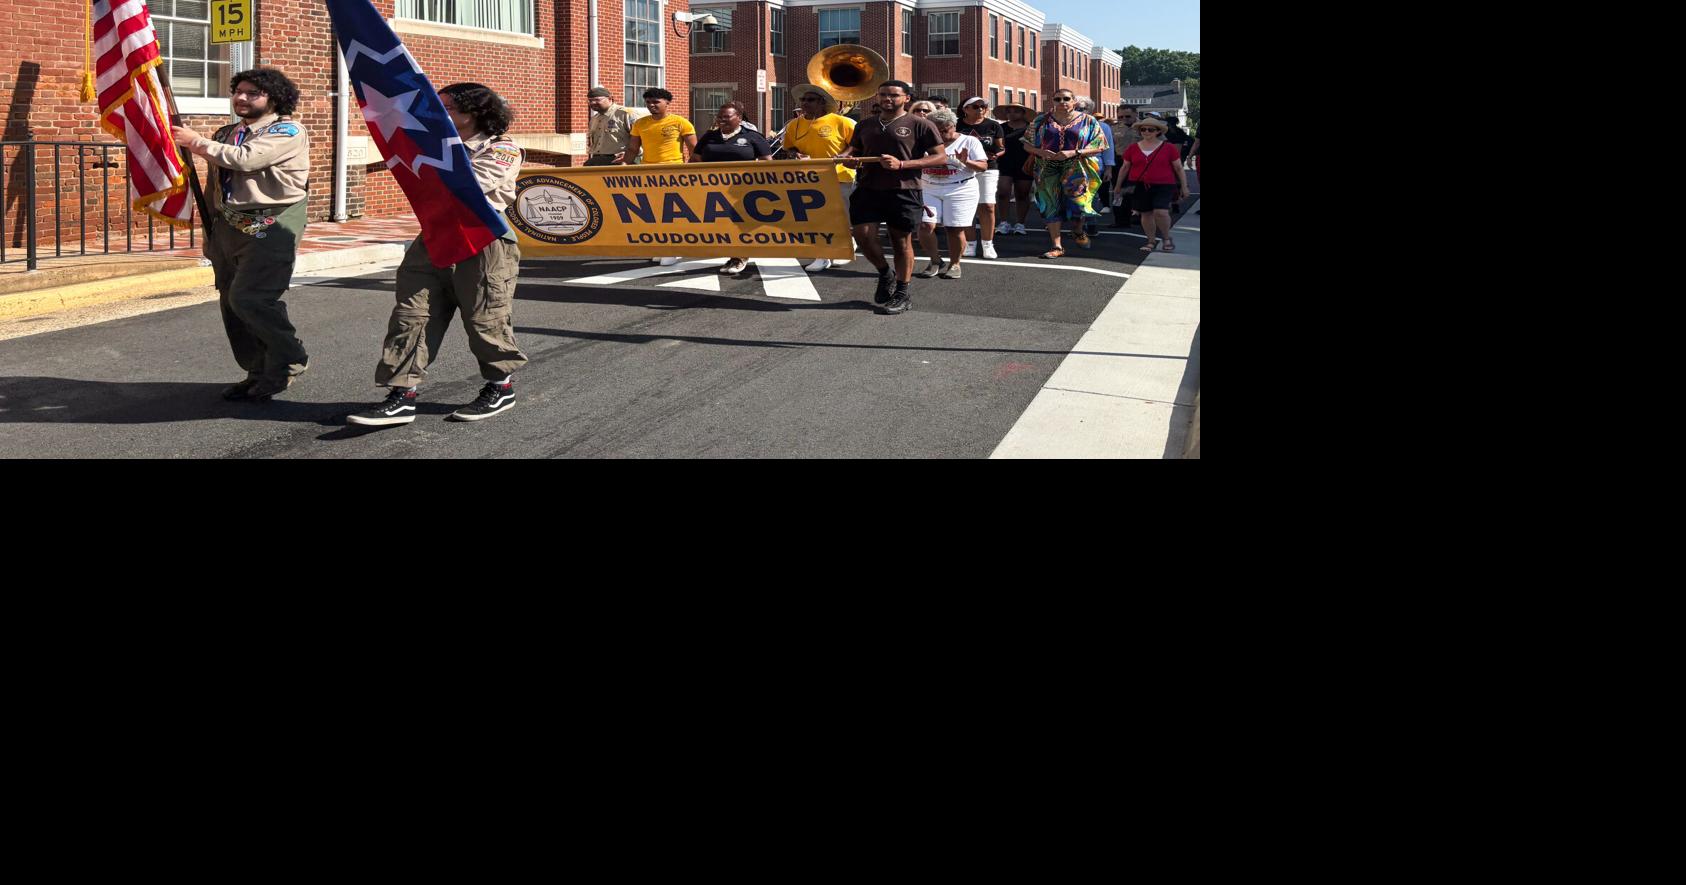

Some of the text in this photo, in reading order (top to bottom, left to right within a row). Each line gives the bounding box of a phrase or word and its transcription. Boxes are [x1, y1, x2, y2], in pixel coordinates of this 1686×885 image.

[218, 3, 243, 25] 15
[219, 28, 243, 38] MPH
[536, 178, 587, 198] ADVANCEMENT
[602, 170, 820, 189] WWW.NAACPLOUDOUN.ORG
[611, 188, 826, 224] NAACP
[524, 227, 557, 242] NATIONAL
[626, 232, 835, 245] LOUDOUN COUNTY
